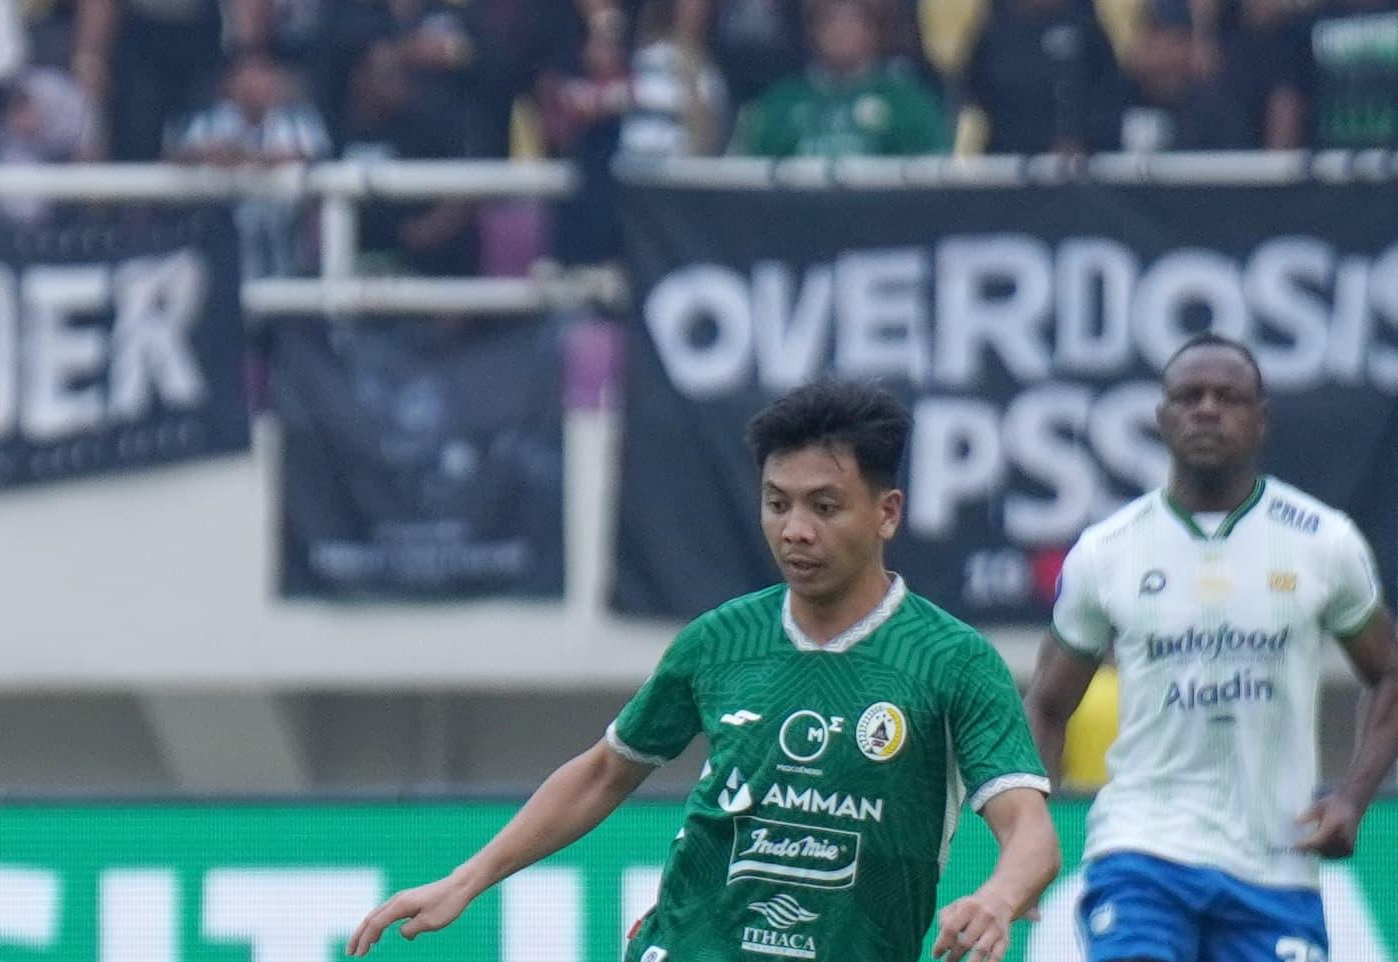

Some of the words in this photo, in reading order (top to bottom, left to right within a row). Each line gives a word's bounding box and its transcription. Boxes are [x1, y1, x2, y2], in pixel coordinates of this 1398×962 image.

[1146, 623, 1292, 662] Indofood
[1165, 667, 1274, 710] Aladin
[760, 782, 884, 823] AMMAN
[742, 926, 816, 951] ITHACA
